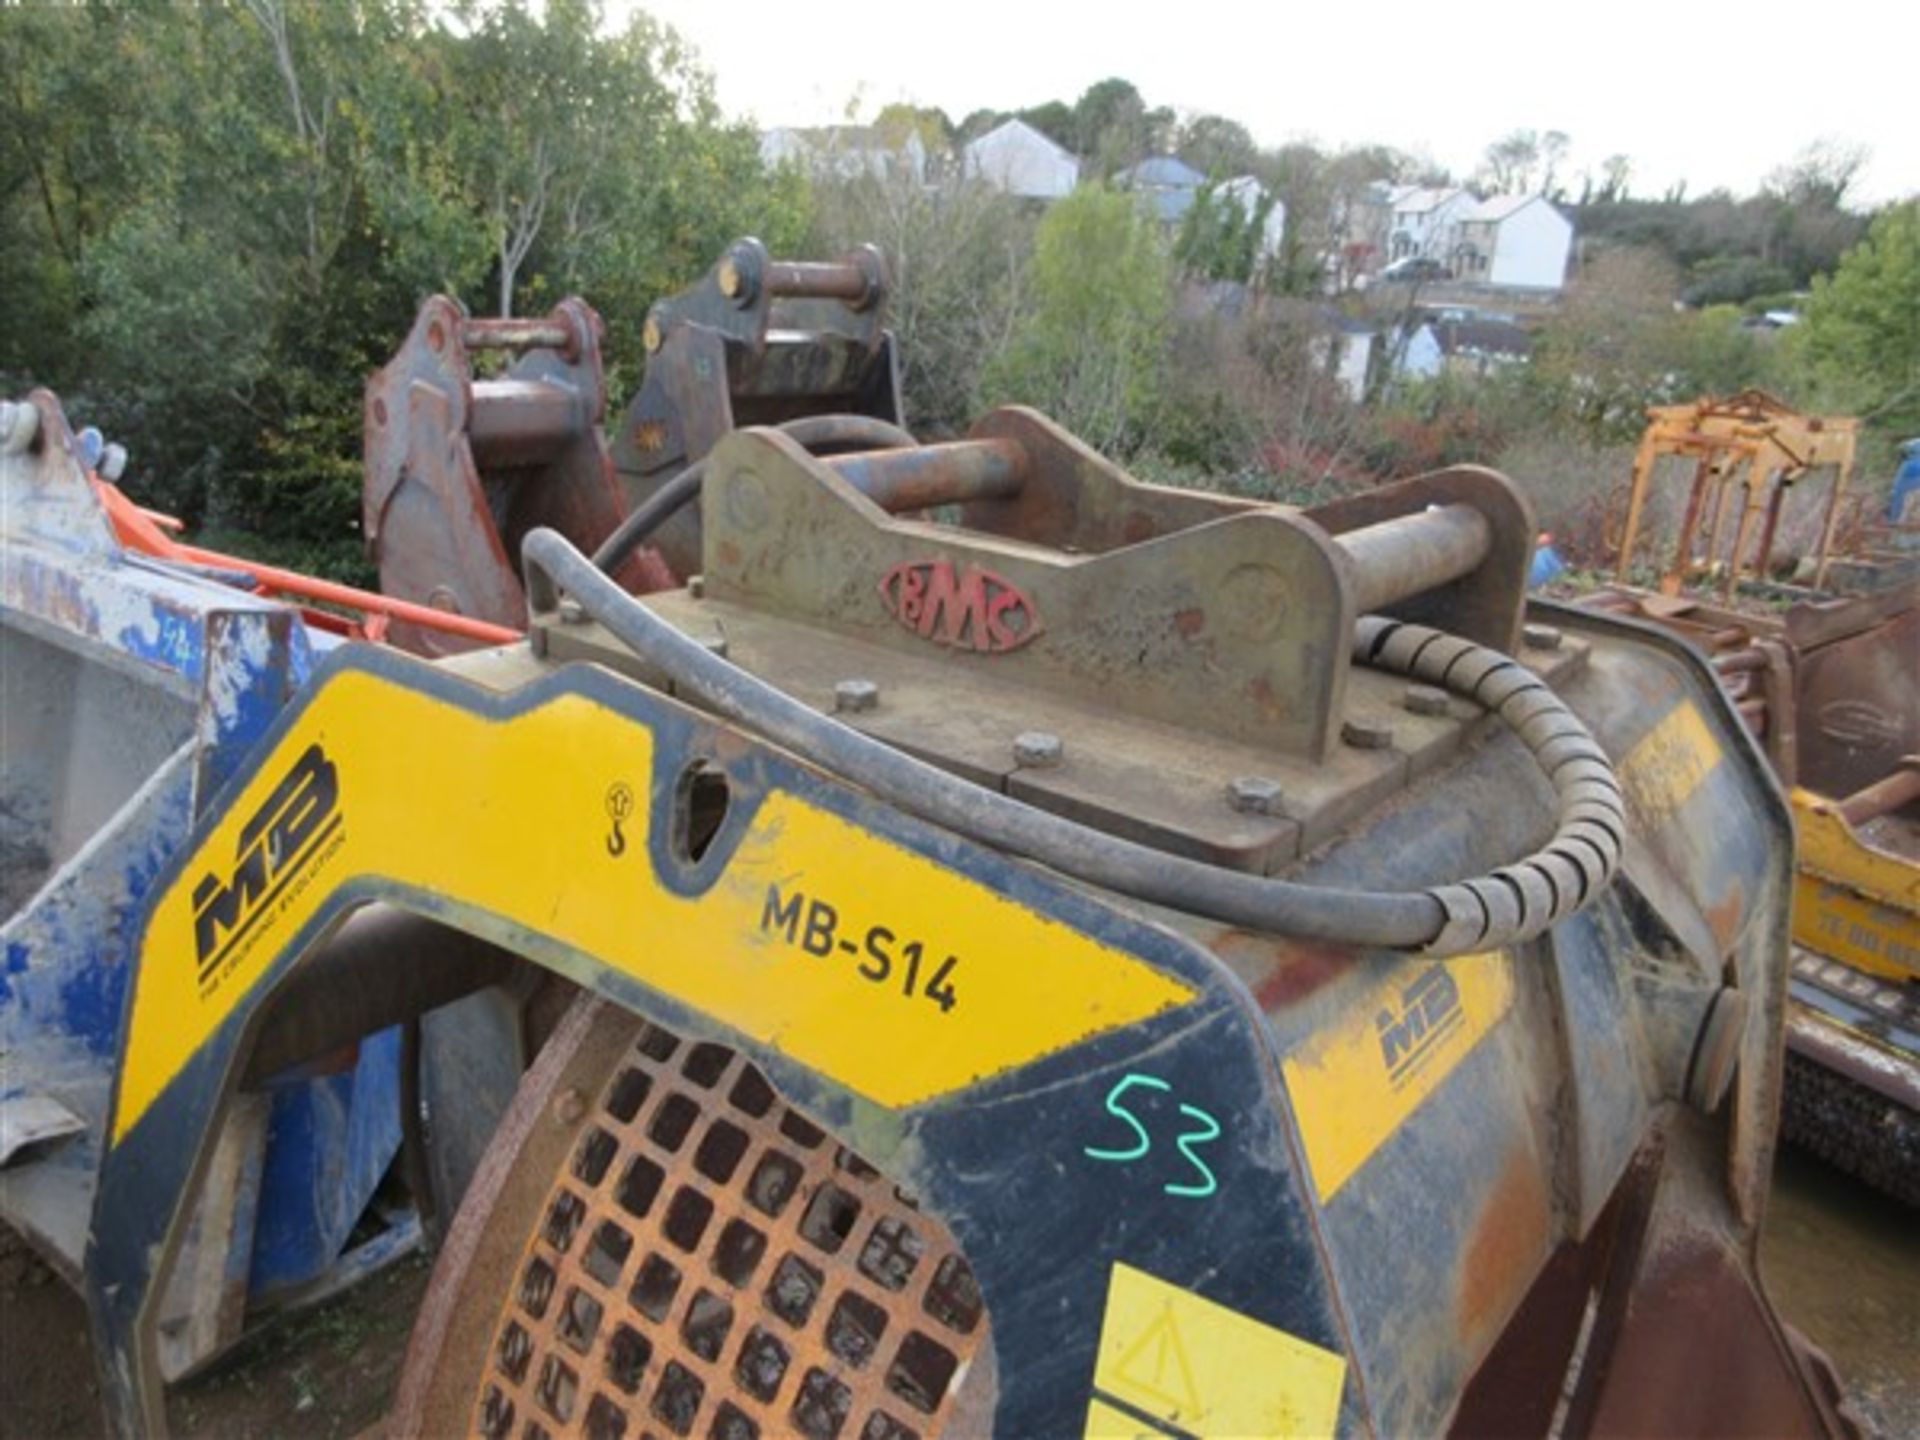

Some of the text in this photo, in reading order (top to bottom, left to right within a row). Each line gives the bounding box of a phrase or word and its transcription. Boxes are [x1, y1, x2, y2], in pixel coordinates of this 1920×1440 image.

[192, 744, 339, 967] MB
[761, 881, 958, 1013] MB-S14
[1376, 961, 1460, 1070] MB
